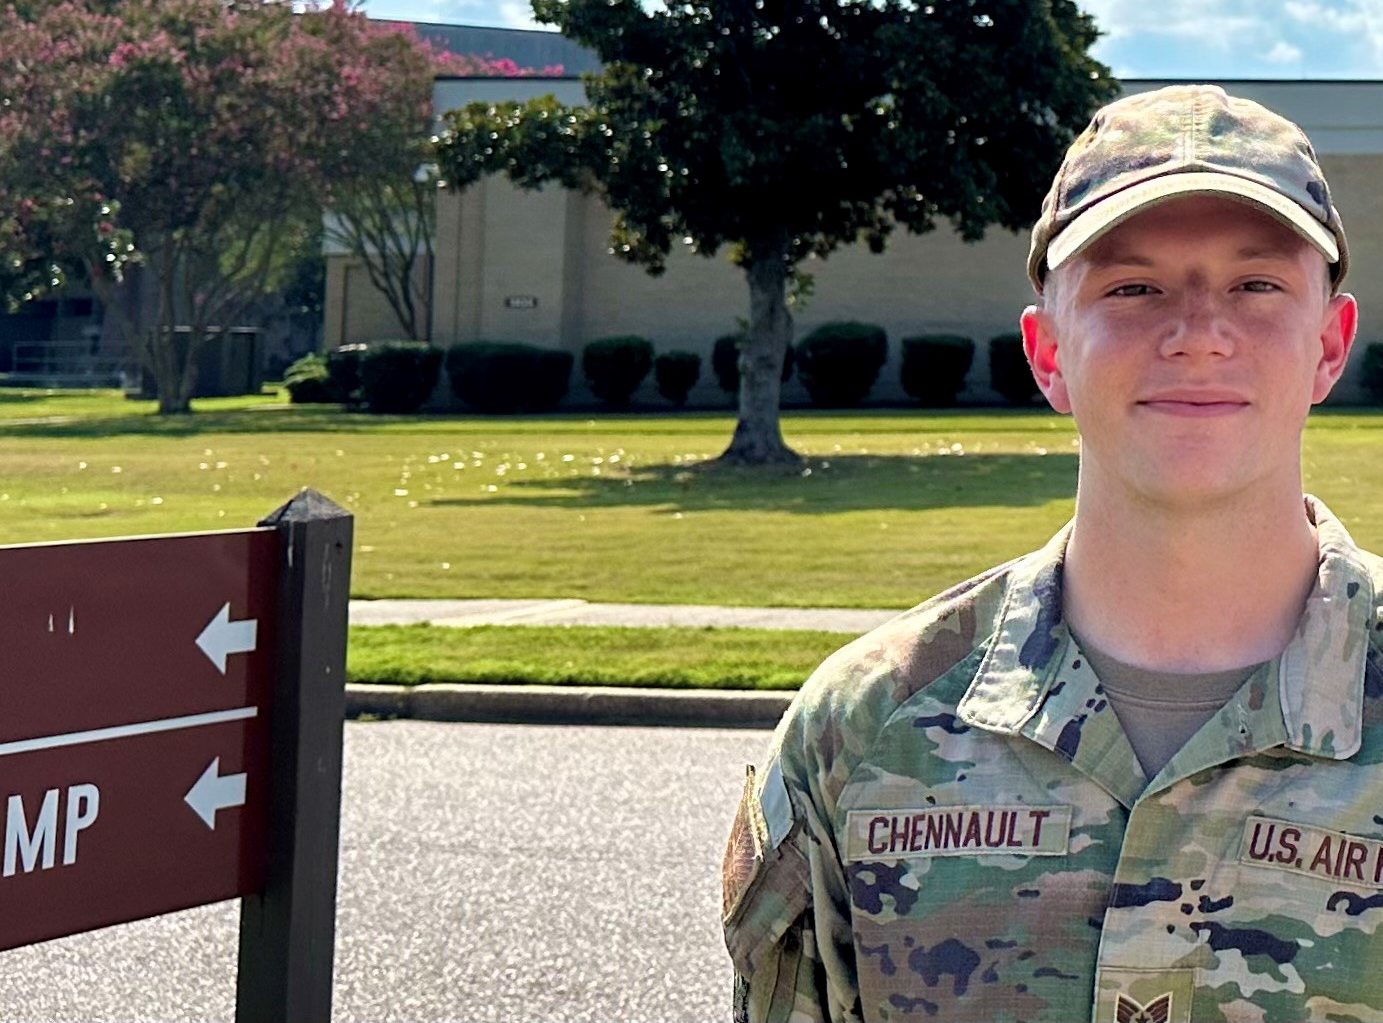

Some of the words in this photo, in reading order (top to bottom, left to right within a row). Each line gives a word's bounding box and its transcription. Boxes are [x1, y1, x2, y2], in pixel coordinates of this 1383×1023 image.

[867, 810, 1051, 856] CHENNAULT
[1249, 821, 1302, 868] U.S.
[1309, 834, 1369, 880] AIR
